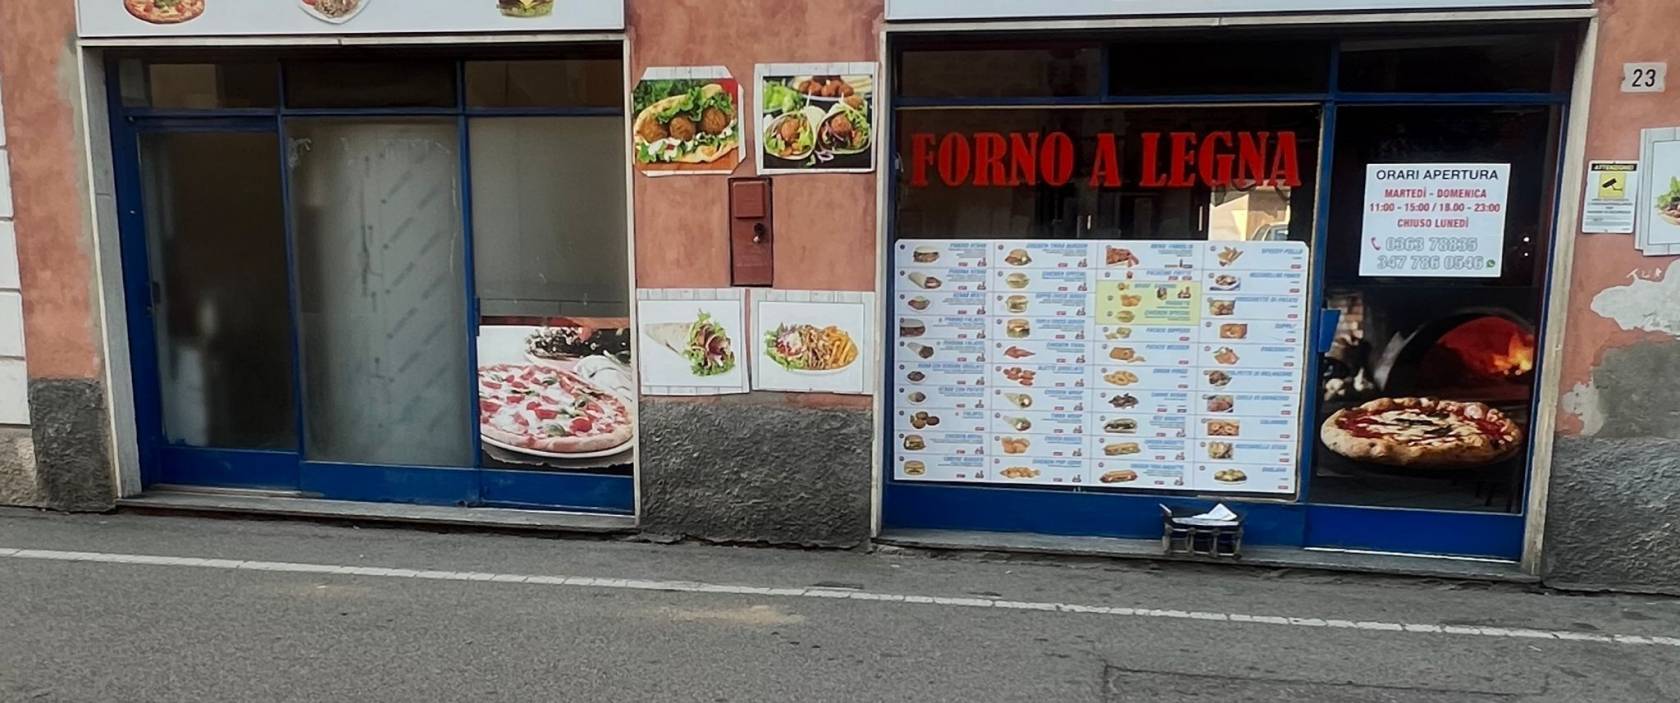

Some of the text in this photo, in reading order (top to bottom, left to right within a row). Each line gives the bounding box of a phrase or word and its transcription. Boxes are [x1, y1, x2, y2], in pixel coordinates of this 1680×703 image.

[1632, 69, 1656, 87] 23
[911, 131, 1302, 187] FORNO A LEGNA
[1376, 169, 1498, 180] ORARI APERTURA
[1437, 189, 1487, 198] DOMENICA
[1370, 203, 1395, 212] 11:00
[1405, 203, 1430, 212] 15:00
[1432, 202, 1437, 212] /
[1474, 203, 1501, 212] 23:00
[1397, 218, 1432, 228] CHIUSO
[1385, 236, 1424, 251] 0363
[1377, 255, 1484, 270] 347 786 0546
